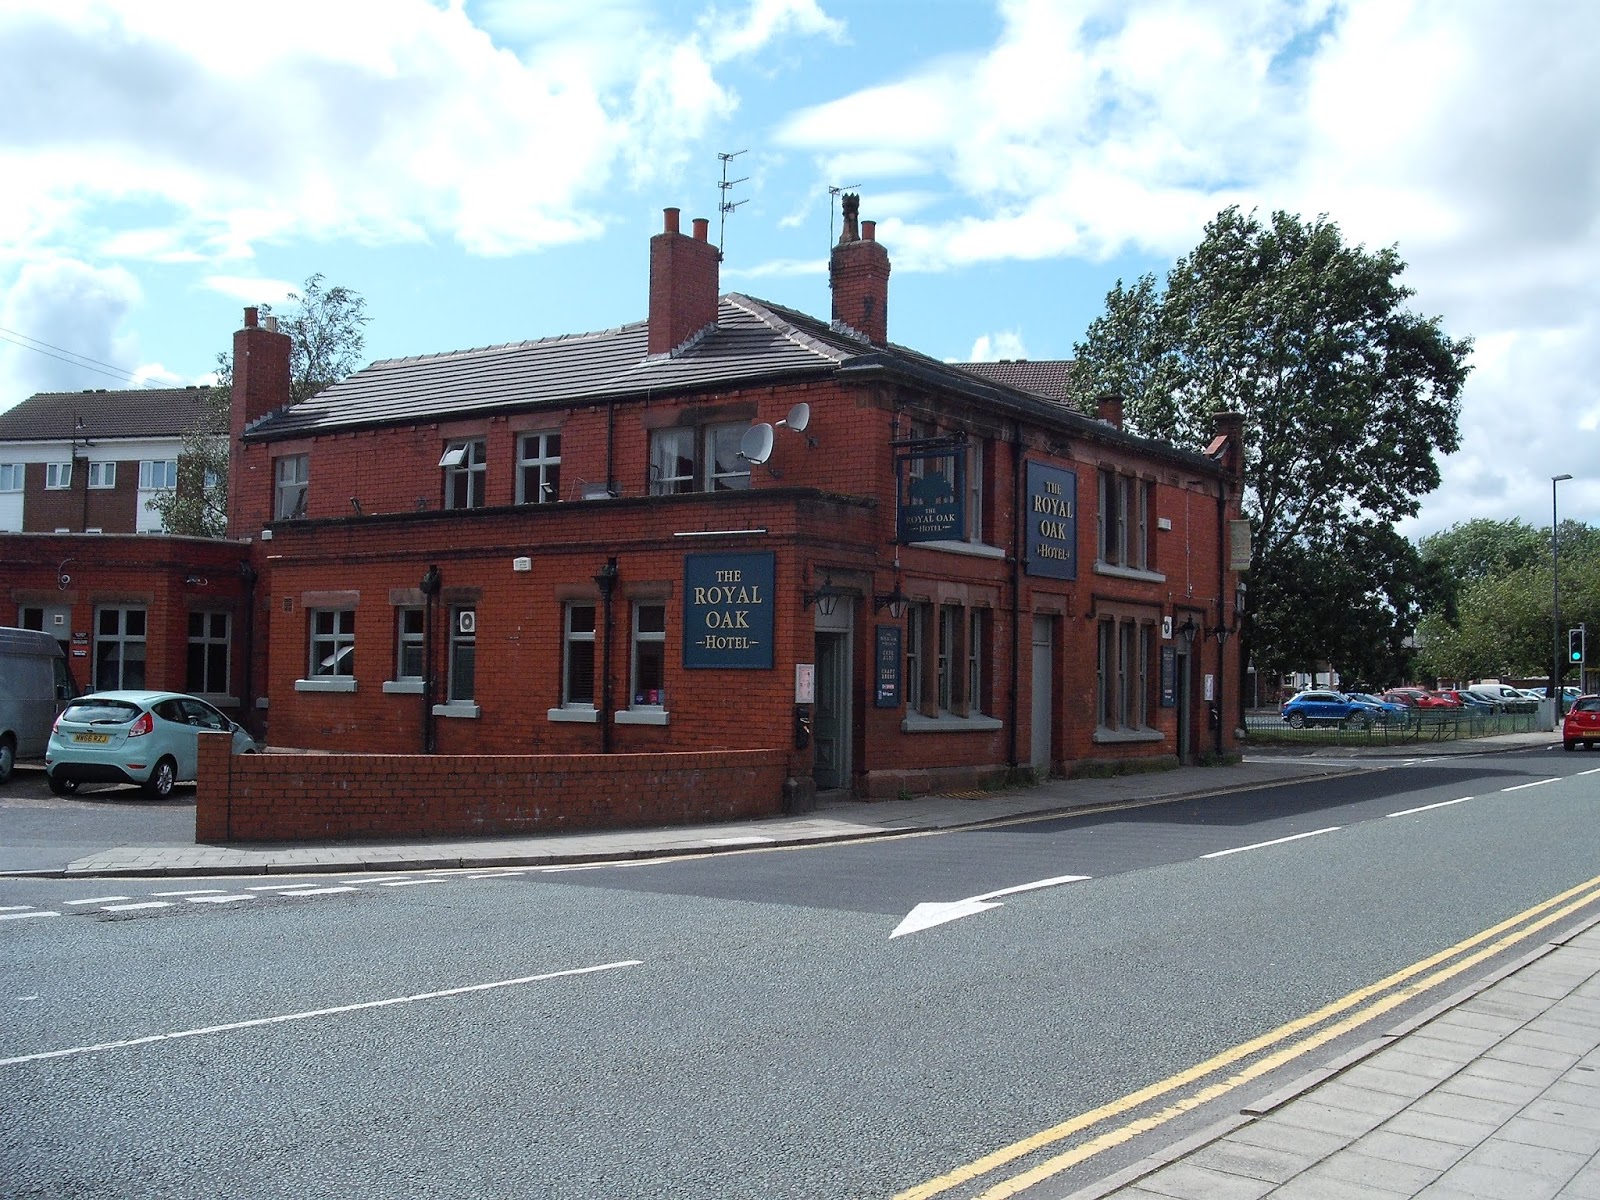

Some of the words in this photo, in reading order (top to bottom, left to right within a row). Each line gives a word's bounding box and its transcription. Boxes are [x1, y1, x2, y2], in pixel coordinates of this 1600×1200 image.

[1046, 481, 1062, 495] THE
[1034, 494, 1073, 518] ROYAL
[936, 513, 955, 522] OAK
[919, 524, 943, 532] HOTEL
[1041, 519, 1066, 540] OAK
[1041, 543, 1067, 560] HOTEL
[716, 570, 742, 582] THE
[694, 585, 763, 605] ROYAL
[705, 610, 750, 629] OAK
[705, 635, 750, 649] HOTEL
